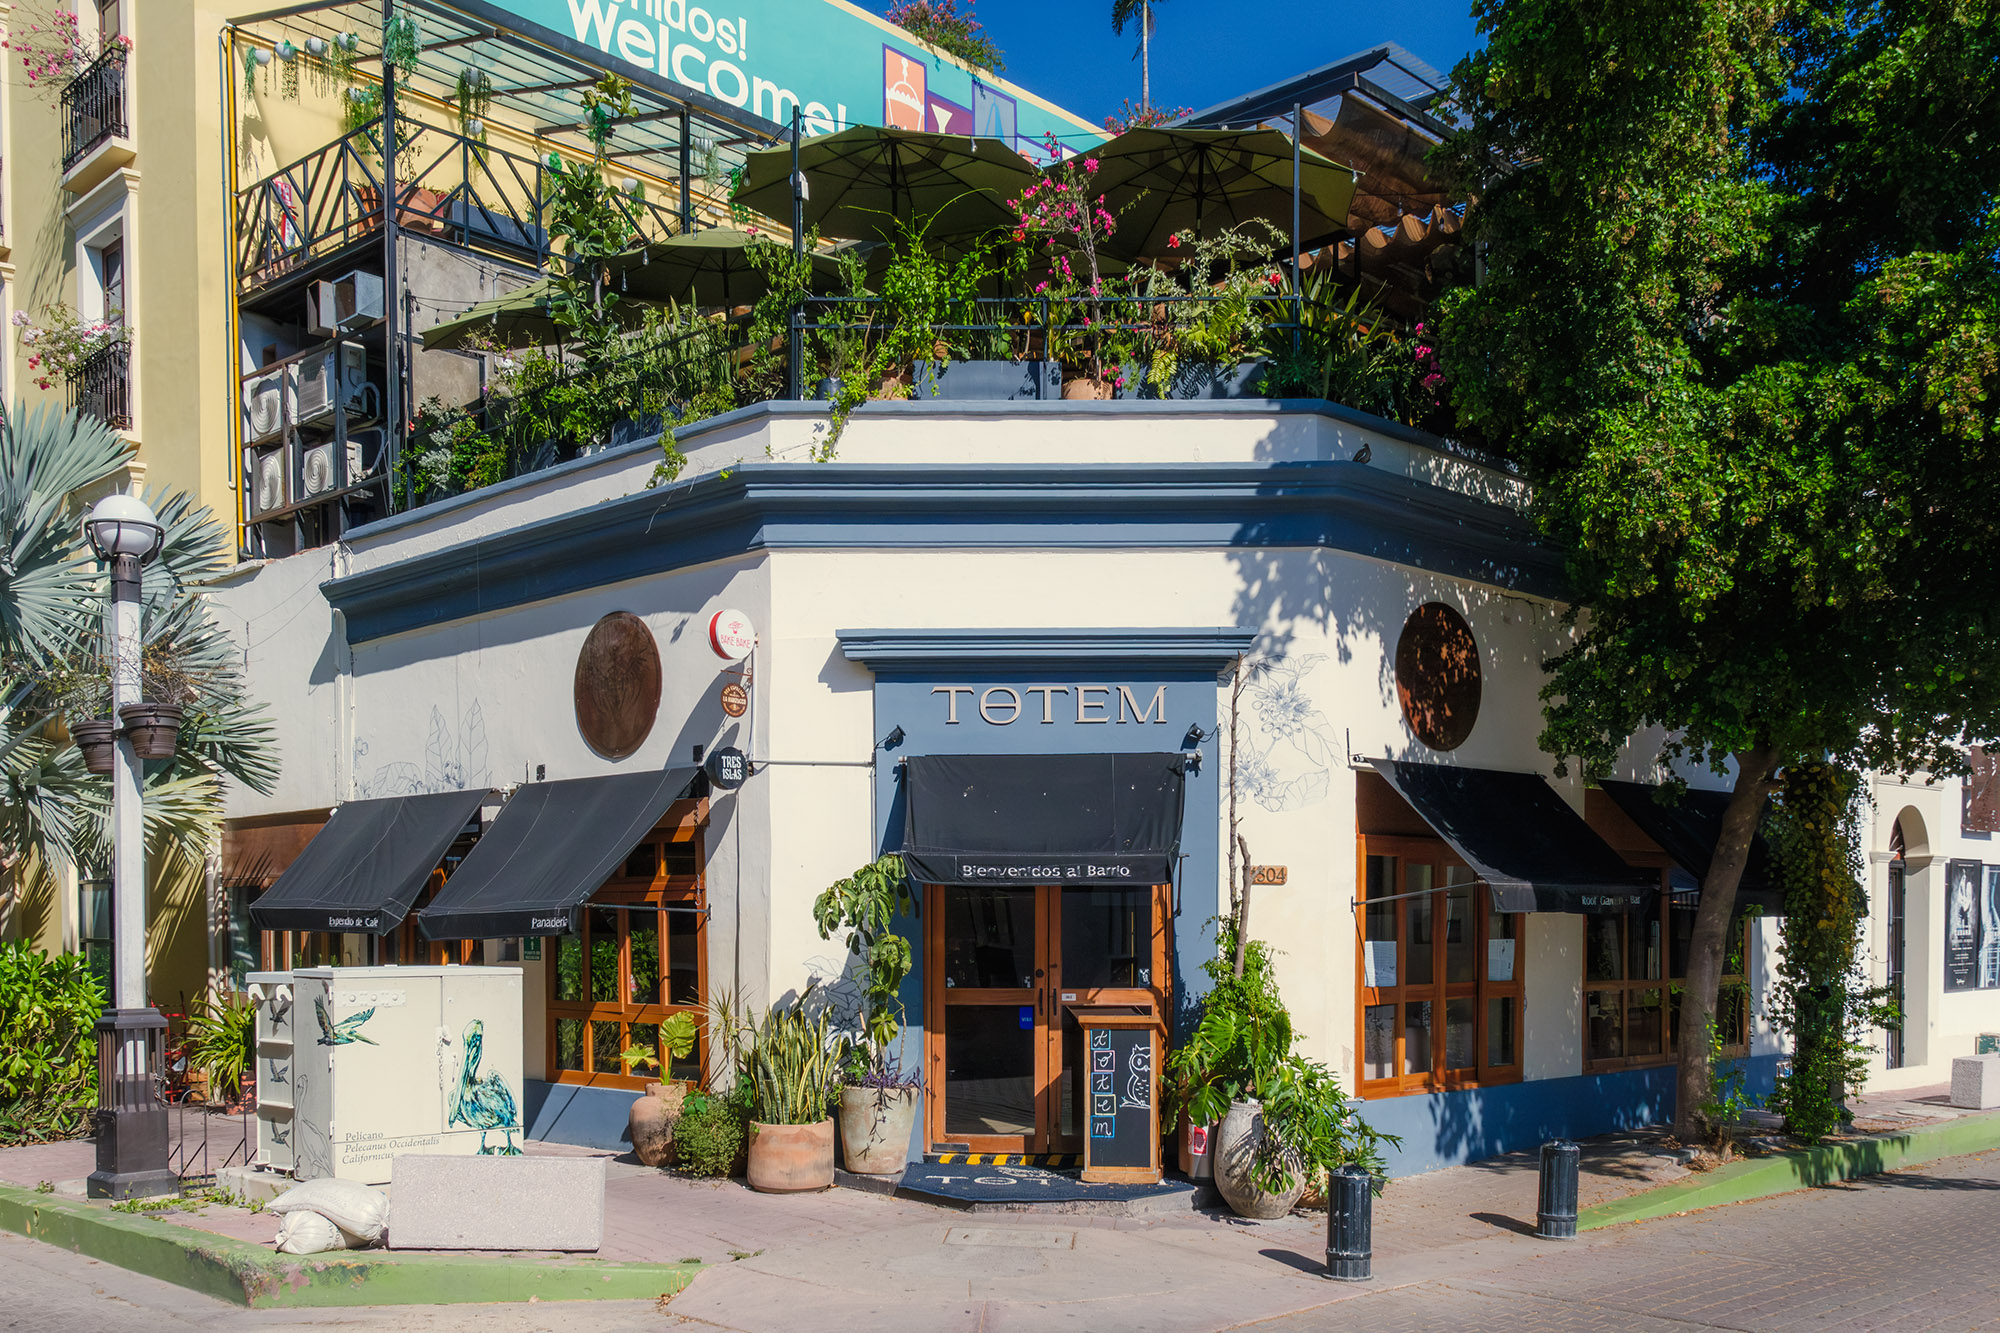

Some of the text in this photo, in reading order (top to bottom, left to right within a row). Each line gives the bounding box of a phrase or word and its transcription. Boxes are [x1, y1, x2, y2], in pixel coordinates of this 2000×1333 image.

[566, 0, 847, 136] Welcome!
[931, 685, 1168, 726] TOTEM
[721, 755, 742, 769] TRES
[722, 768, 742, 780] ISLAS
[962, 864, 1131, 878] Bienvenidos al Barrio
[344, 1136, 440, 1154] Pelecanus Occidentalis
[342, 1152, 395, 1165] Californicus
